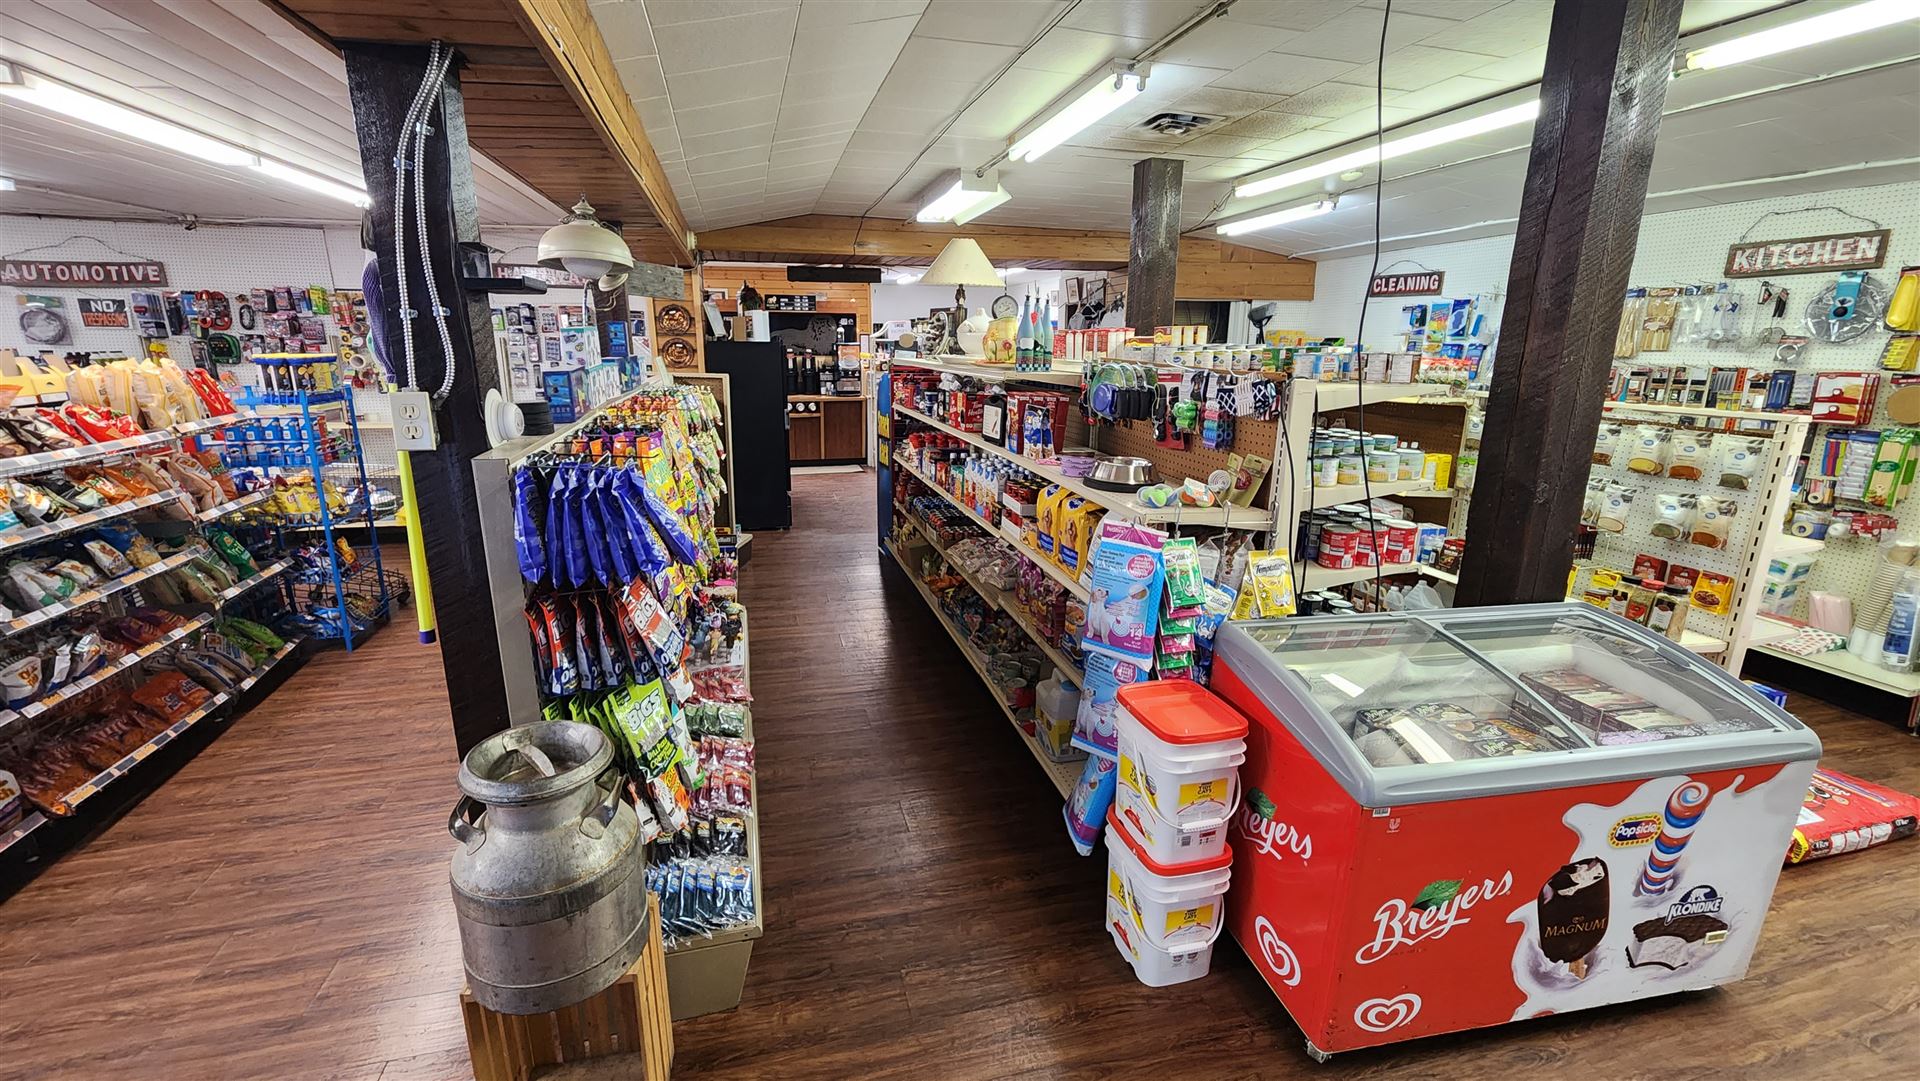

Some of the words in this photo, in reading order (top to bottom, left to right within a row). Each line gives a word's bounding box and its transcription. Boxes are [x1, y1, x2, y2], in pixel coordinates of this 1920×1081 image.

[1732, 236, 1882, 271] KITCHEN
[1, 263, 161, 282] AUTOMOTIVE
[1373, 274, 1439, 293] CLEANING
[89, 300, 114, 312] NO
[82, 312, 129, 327] TRESPASSING
[1130, 628, 1143, 638] 14
[1239, 801, 1313, 860] reyers
[1616, 821, 1658, 838] Popsicle
[1355, 870, 1513, 965] Breyers
[1665, 898, 1722, 923] KLONDIKE
[1544, 916, 1608, 938] MAGNUM
